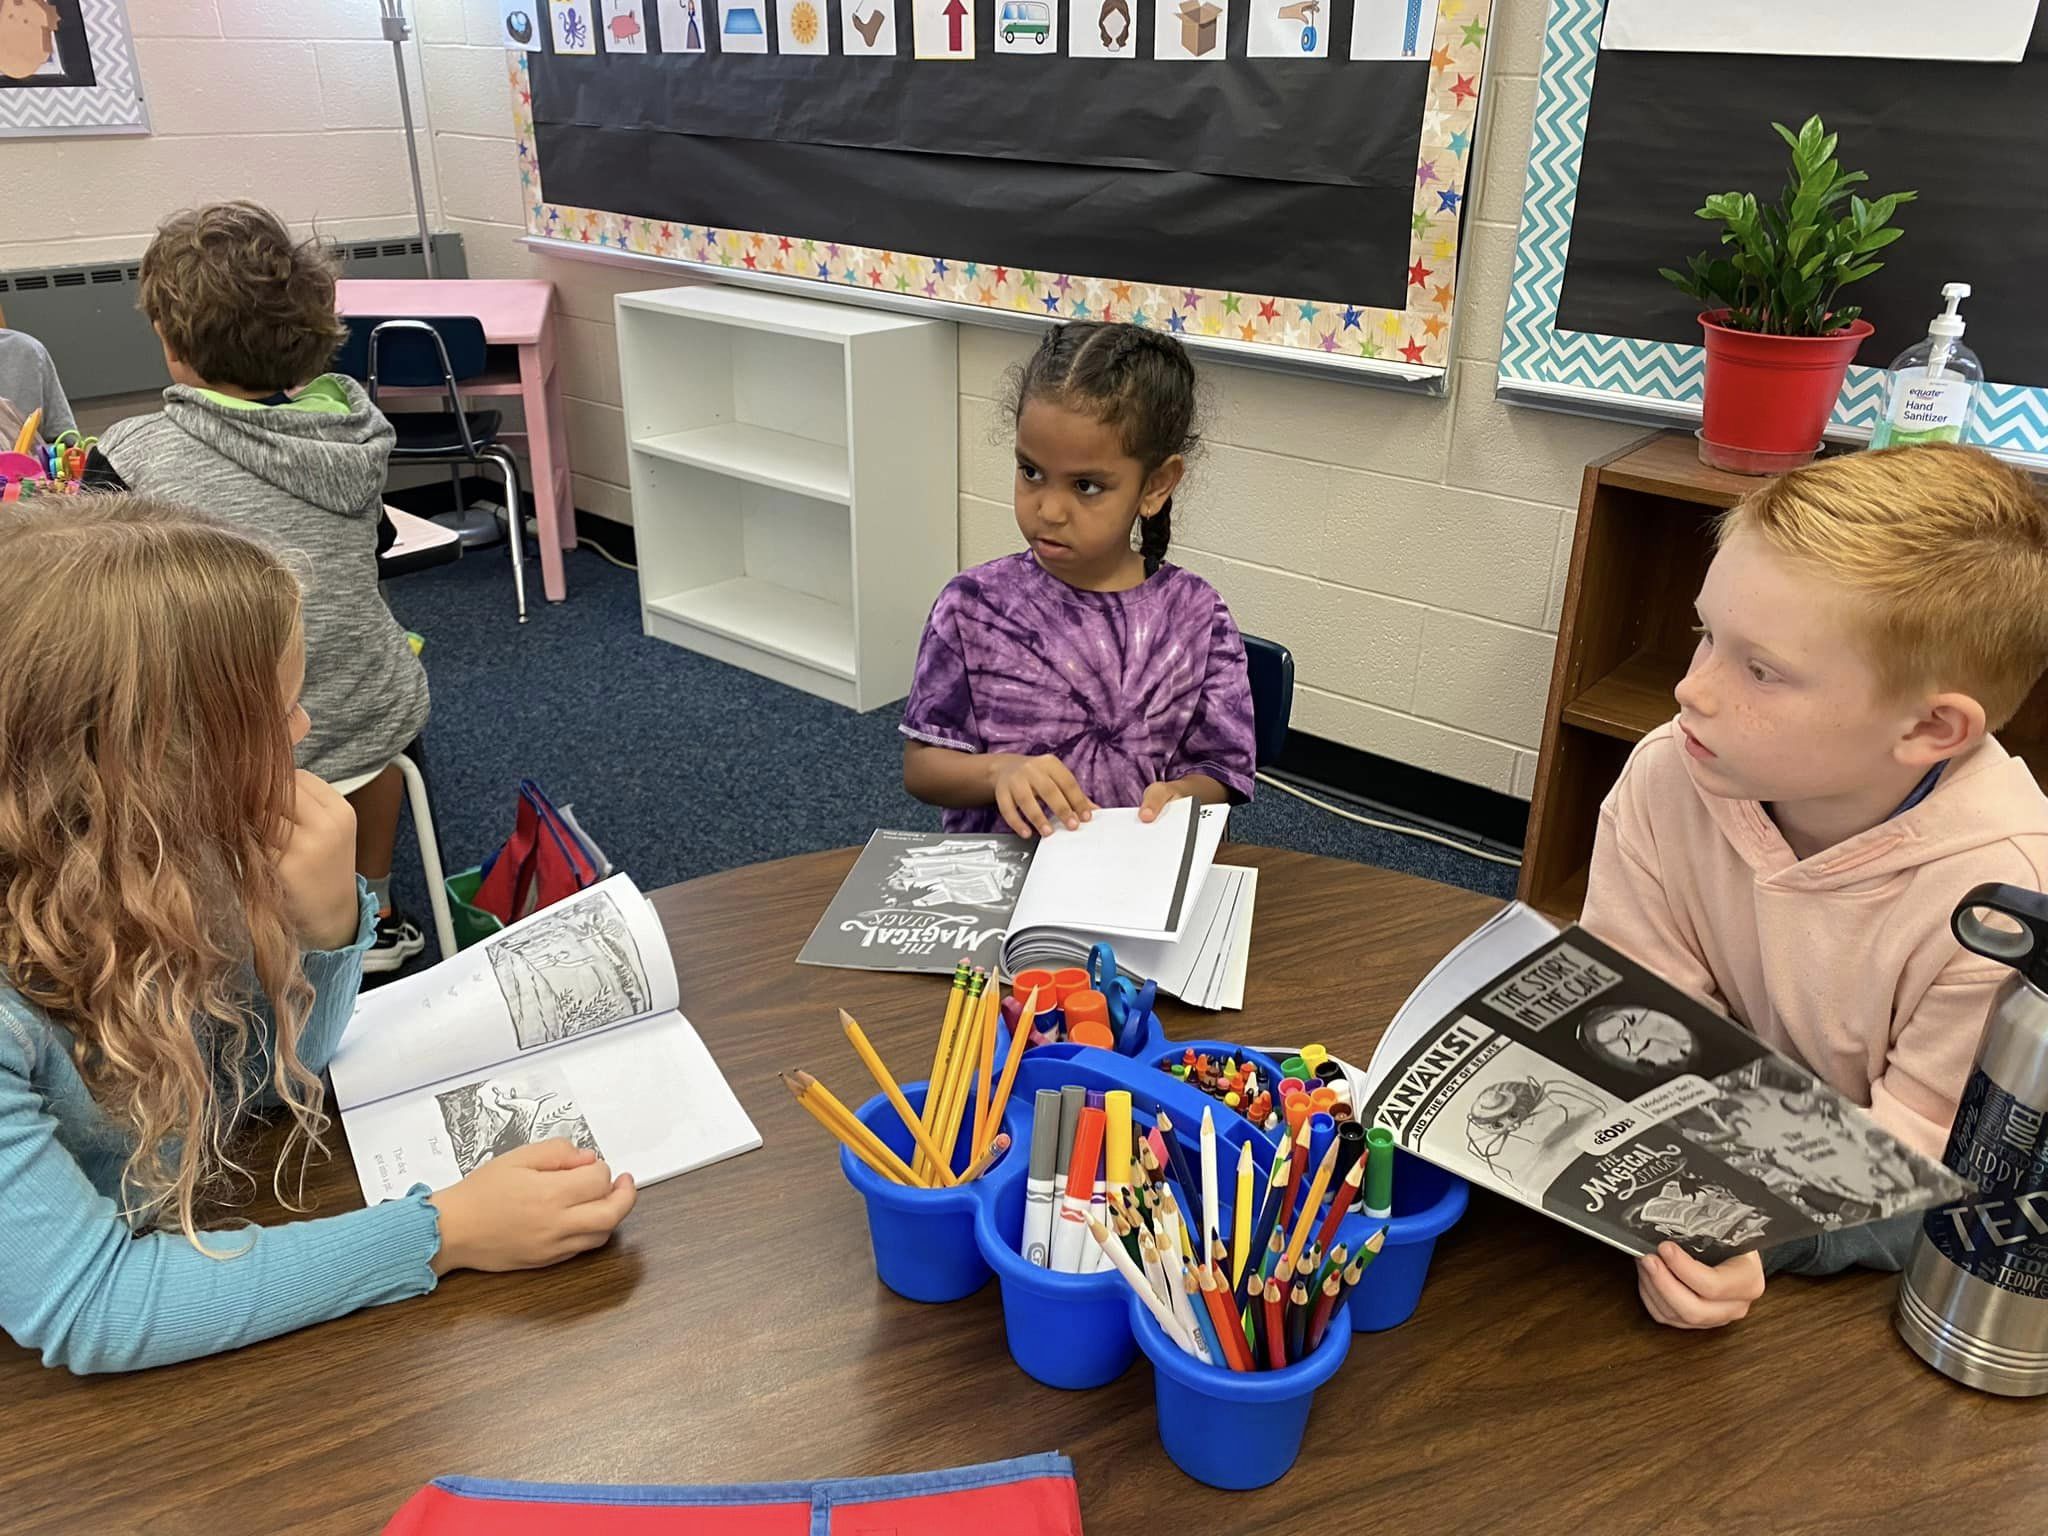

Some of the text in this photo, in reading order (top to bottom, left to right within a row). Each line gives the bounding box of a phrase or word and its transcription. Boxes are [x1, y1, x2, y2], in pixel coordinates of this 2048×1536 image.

[1906, 400, 1934, 411] Hand
[1909, 389, 1941, 398] equate
[1903, 410, 1948, 423] Sanitizer
[868, 913, 936, 928] STACK
[839, 920, 1007, 952] MAGICAL
[896, 942, 936, 955] THE
[1491, 951, 1581, 1011] THE STORY
[1515, 964, 1616, 1028] IN THE CAVE
[1377, 1026, 1479, 1130] ANANSI
[1411, 1042, 1501, 1140] AND THE POT OF BEANS
[1595, 1152, 1622, 1172] THE
[1636, 1156, 1679, 1184] STACK
[1968, 1139, 2025, 1190] TEDDY
[1580, 1143, 1682, 1212] MAGICAL
[1998, 1265, 2043, 1293] TEDDY
